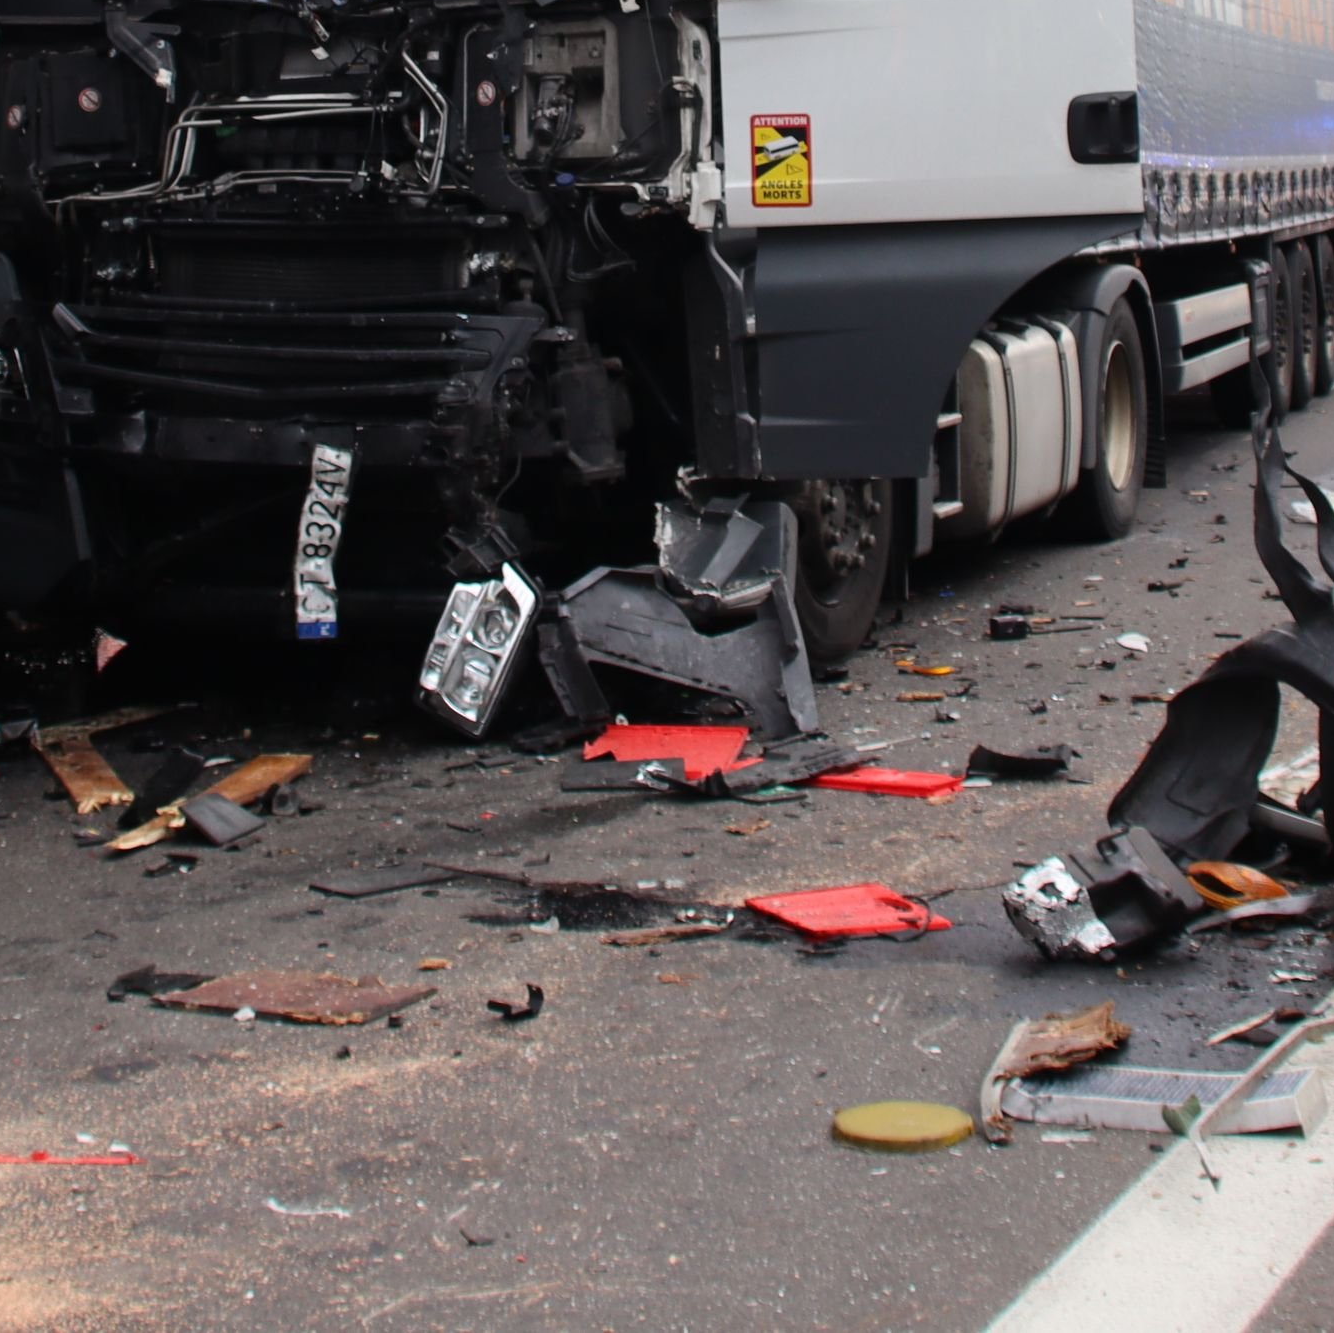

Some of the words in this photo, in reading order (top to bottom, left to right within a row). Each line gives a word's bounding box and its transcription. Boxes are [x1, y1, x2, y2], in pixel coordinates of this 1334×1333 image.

[754, 116, 807, 126] ATTENTION
[761, 179, 803, 190] ANGLES
[763, 190, 802, 200] MORTS
